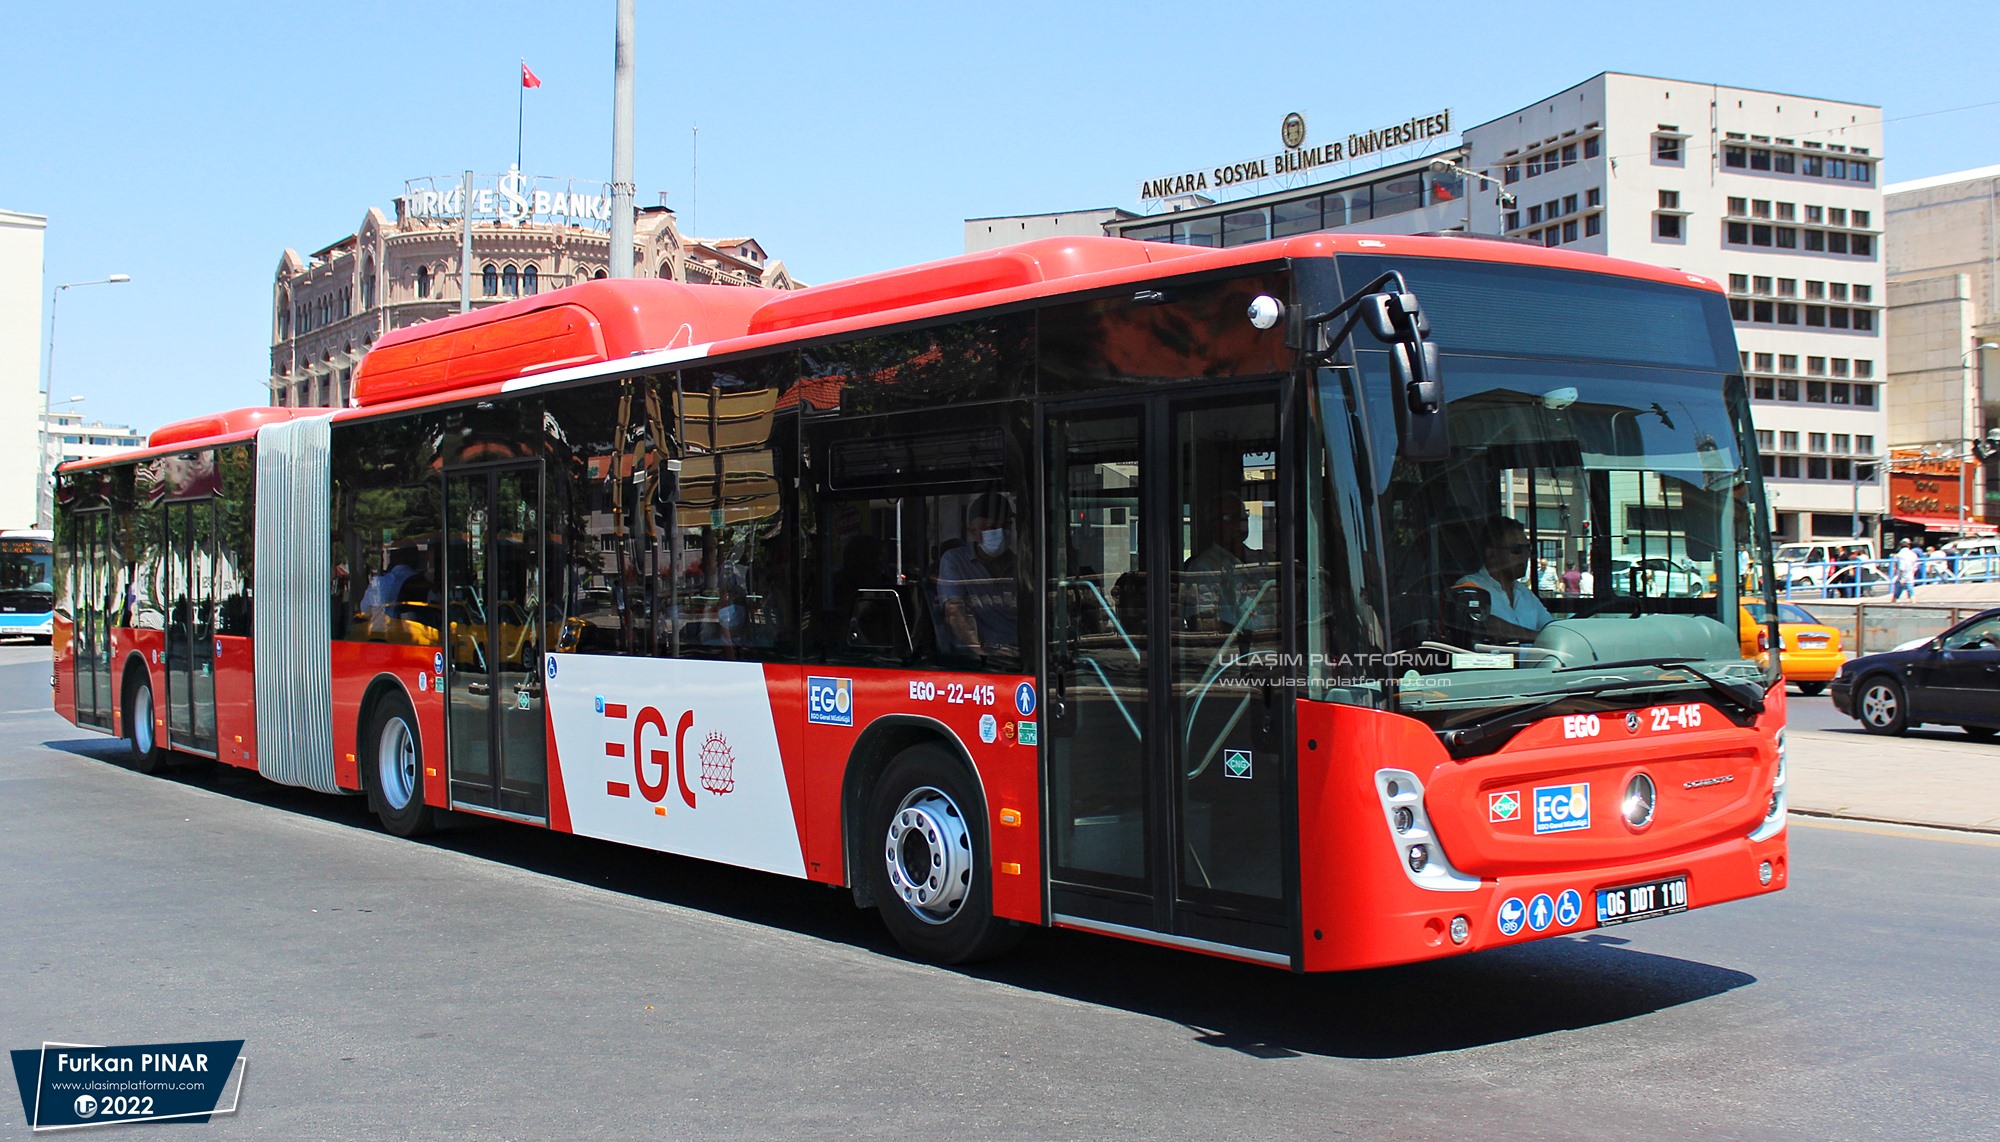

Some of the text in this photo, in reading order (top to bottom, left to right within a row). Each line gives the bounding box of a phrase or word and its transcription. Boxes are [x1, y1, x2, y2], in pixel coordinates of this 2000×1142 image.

[1141, 108, 1450, 199] ANKARA SOSYAL BİLİMLER ÜNİVERSİTESİ
[811, 685, 850, 713] EGO
[909, 681, 935, 701] EGO
[947, 683, 995, 706] 22-415
[1564, 705, 1701, 739] EGO 22-415
[1230, 760, 1247, 769] CNG
[1495, 801, 1517, 812] CNG
[1538, 793, 1587, 823] EGO
[1607, 891, 1626, 917] 06
[1630, 885, 1656, 913] DDT
[1661, 880, 1684, 907] 110
